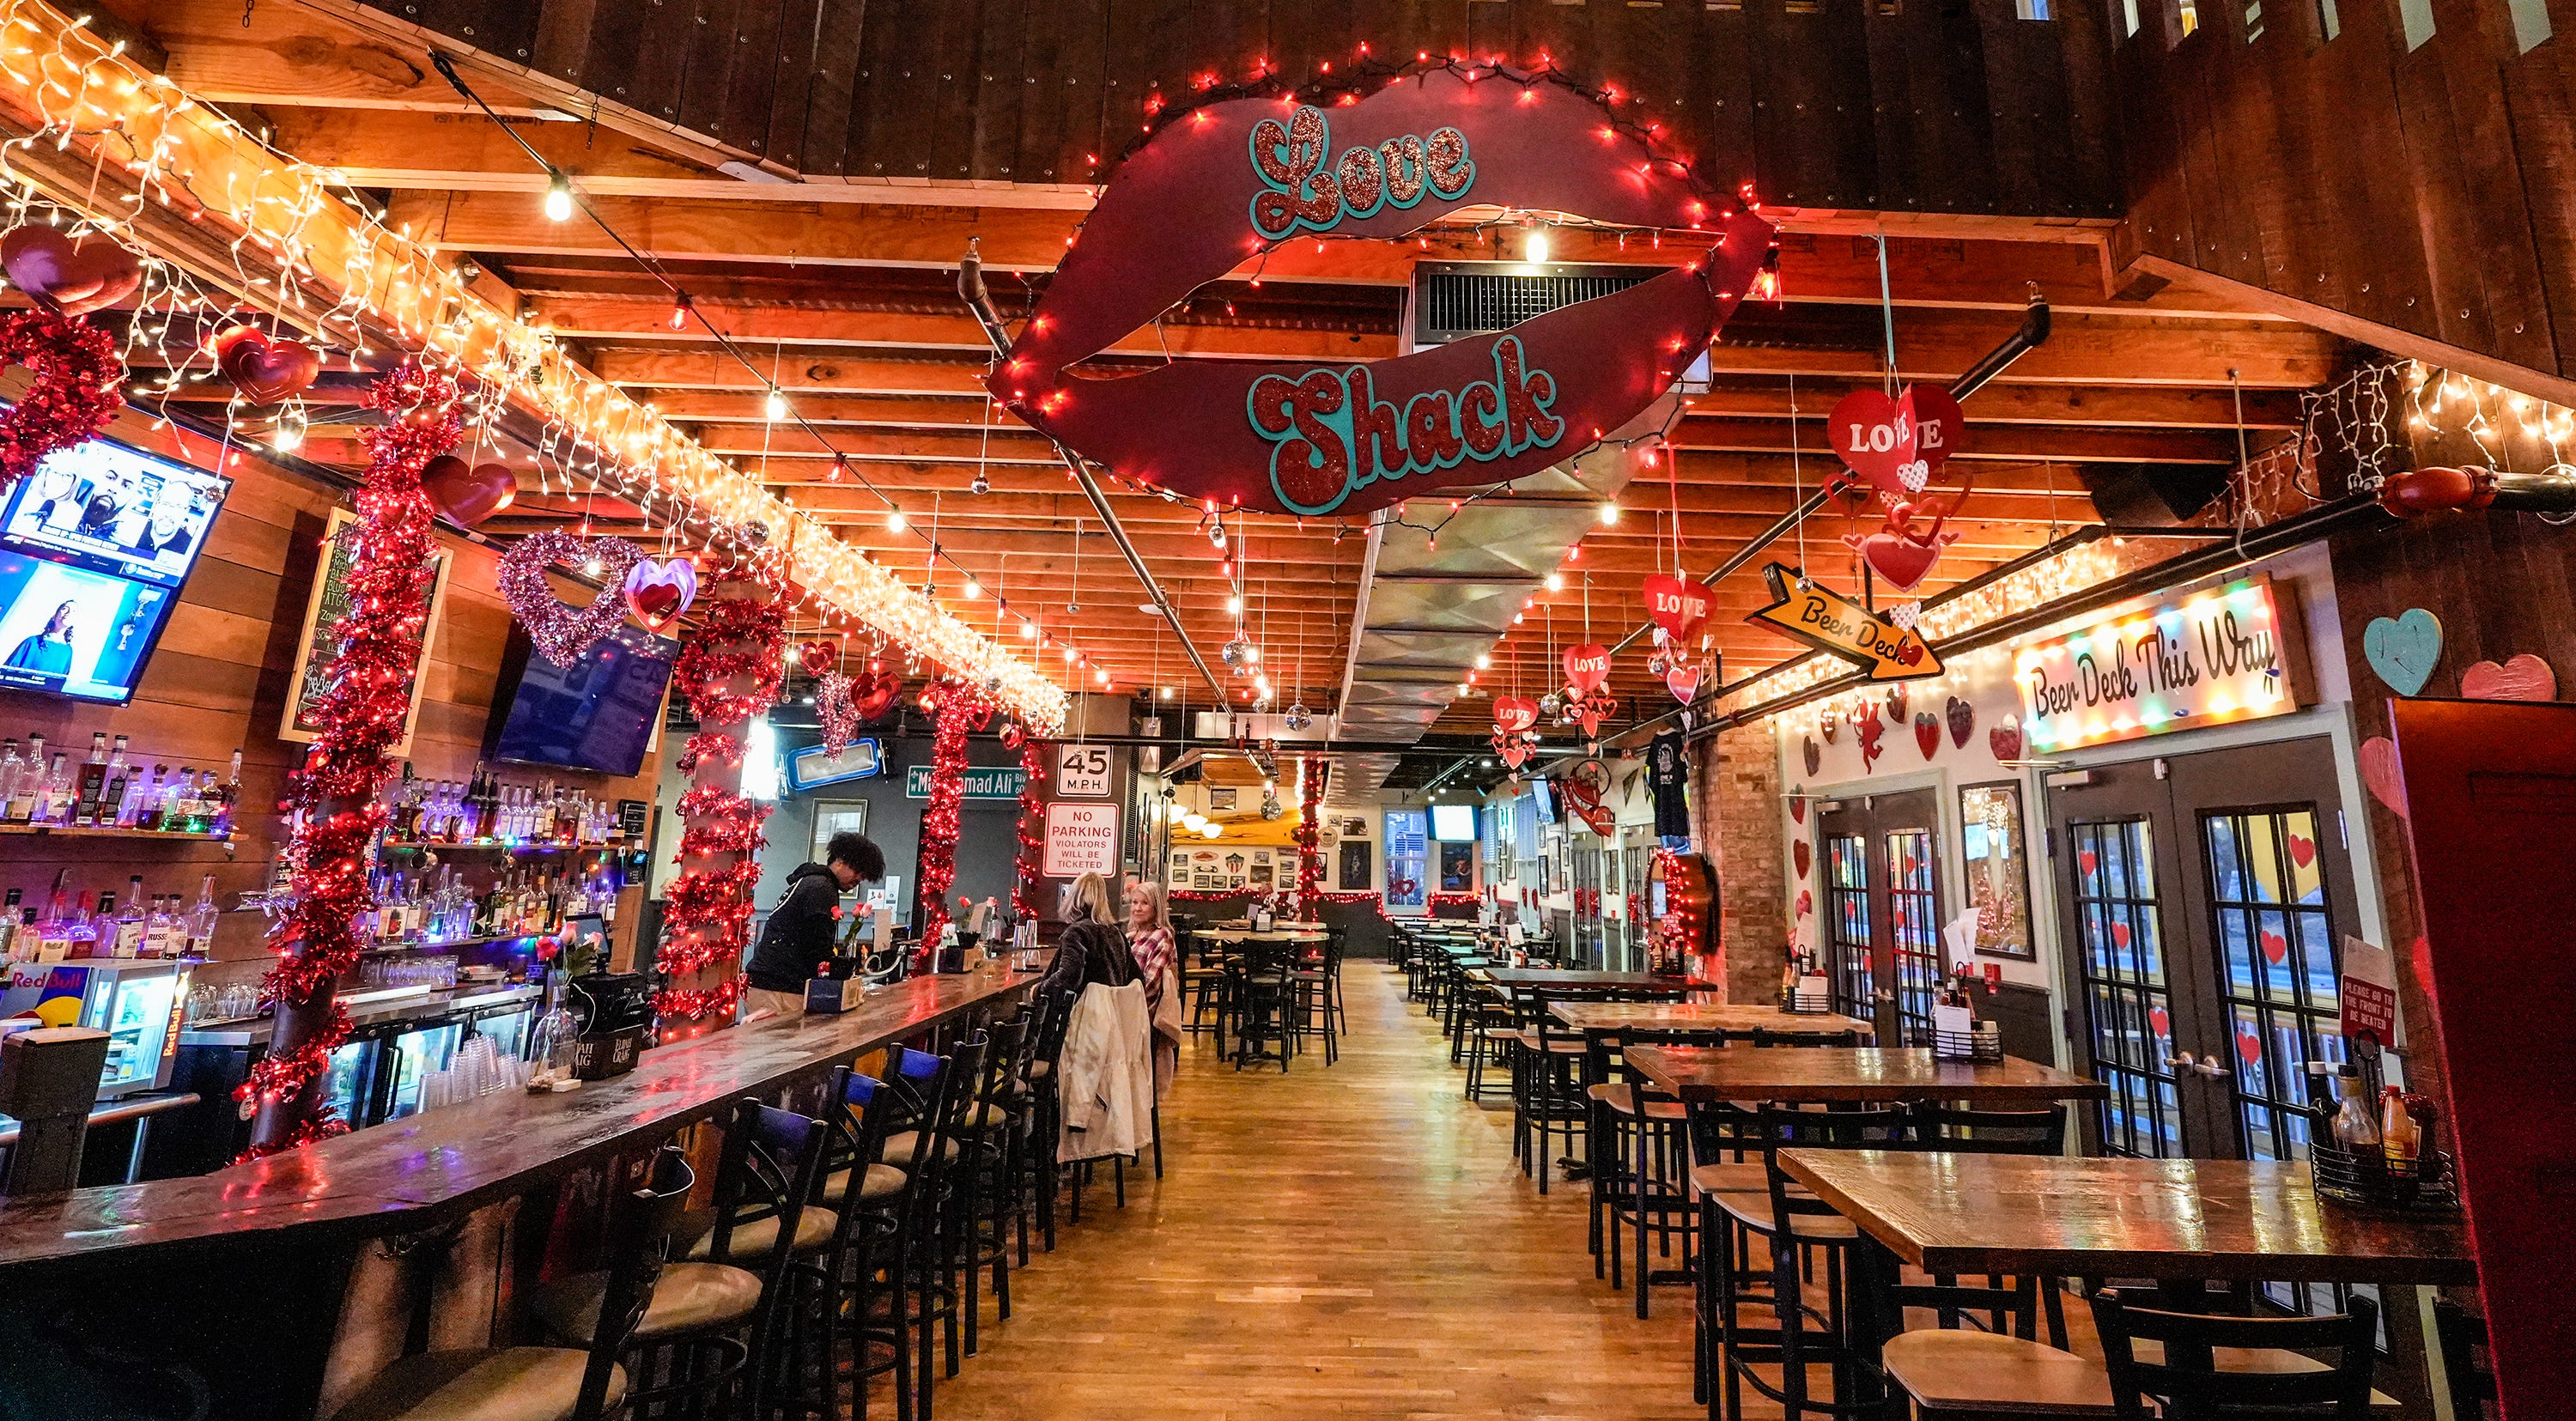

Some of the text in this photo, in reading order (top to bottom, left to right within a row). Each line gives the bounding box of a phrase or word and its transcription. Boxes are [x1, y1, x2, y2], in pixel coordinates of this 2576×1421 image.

[1249, 104, 1476, 240] Love
[1247, 335, 1564, 515] Shack
[1656, 592, 1706, 618] LOVE
[1801, 595, 1909, 666] Beer Deck
[1574, 655, 1606, 673] LOVE
[2031, 610, 2277, 721] Beer Deck This Way
[1499, 707, 1530, 722] LOVE
[1062, 750, 1108, 775] 45
[993, 773, 1012, 794] Ali
[1014, 774, 1027, 783] Blv
[1072, 811, 1092, 823] NO
[1052, 826, 1111, 838] PARKING
[1055, 840, 1107, 849] VIOLATORS
[1061, 850, 1100, 859] WILL BE
[1057, 860, 1103, 869] TICKETED
[11, 972, 82, 989] Red Bull
[2344, 981, 2393, 1005] PLEASE GO TO
[2345, 995, 2393, 1019] THE FRONT TO
[2349, 1010, 2386, 1030] BE SEATED
[162, 1009, 182, 1057] Red Bull
